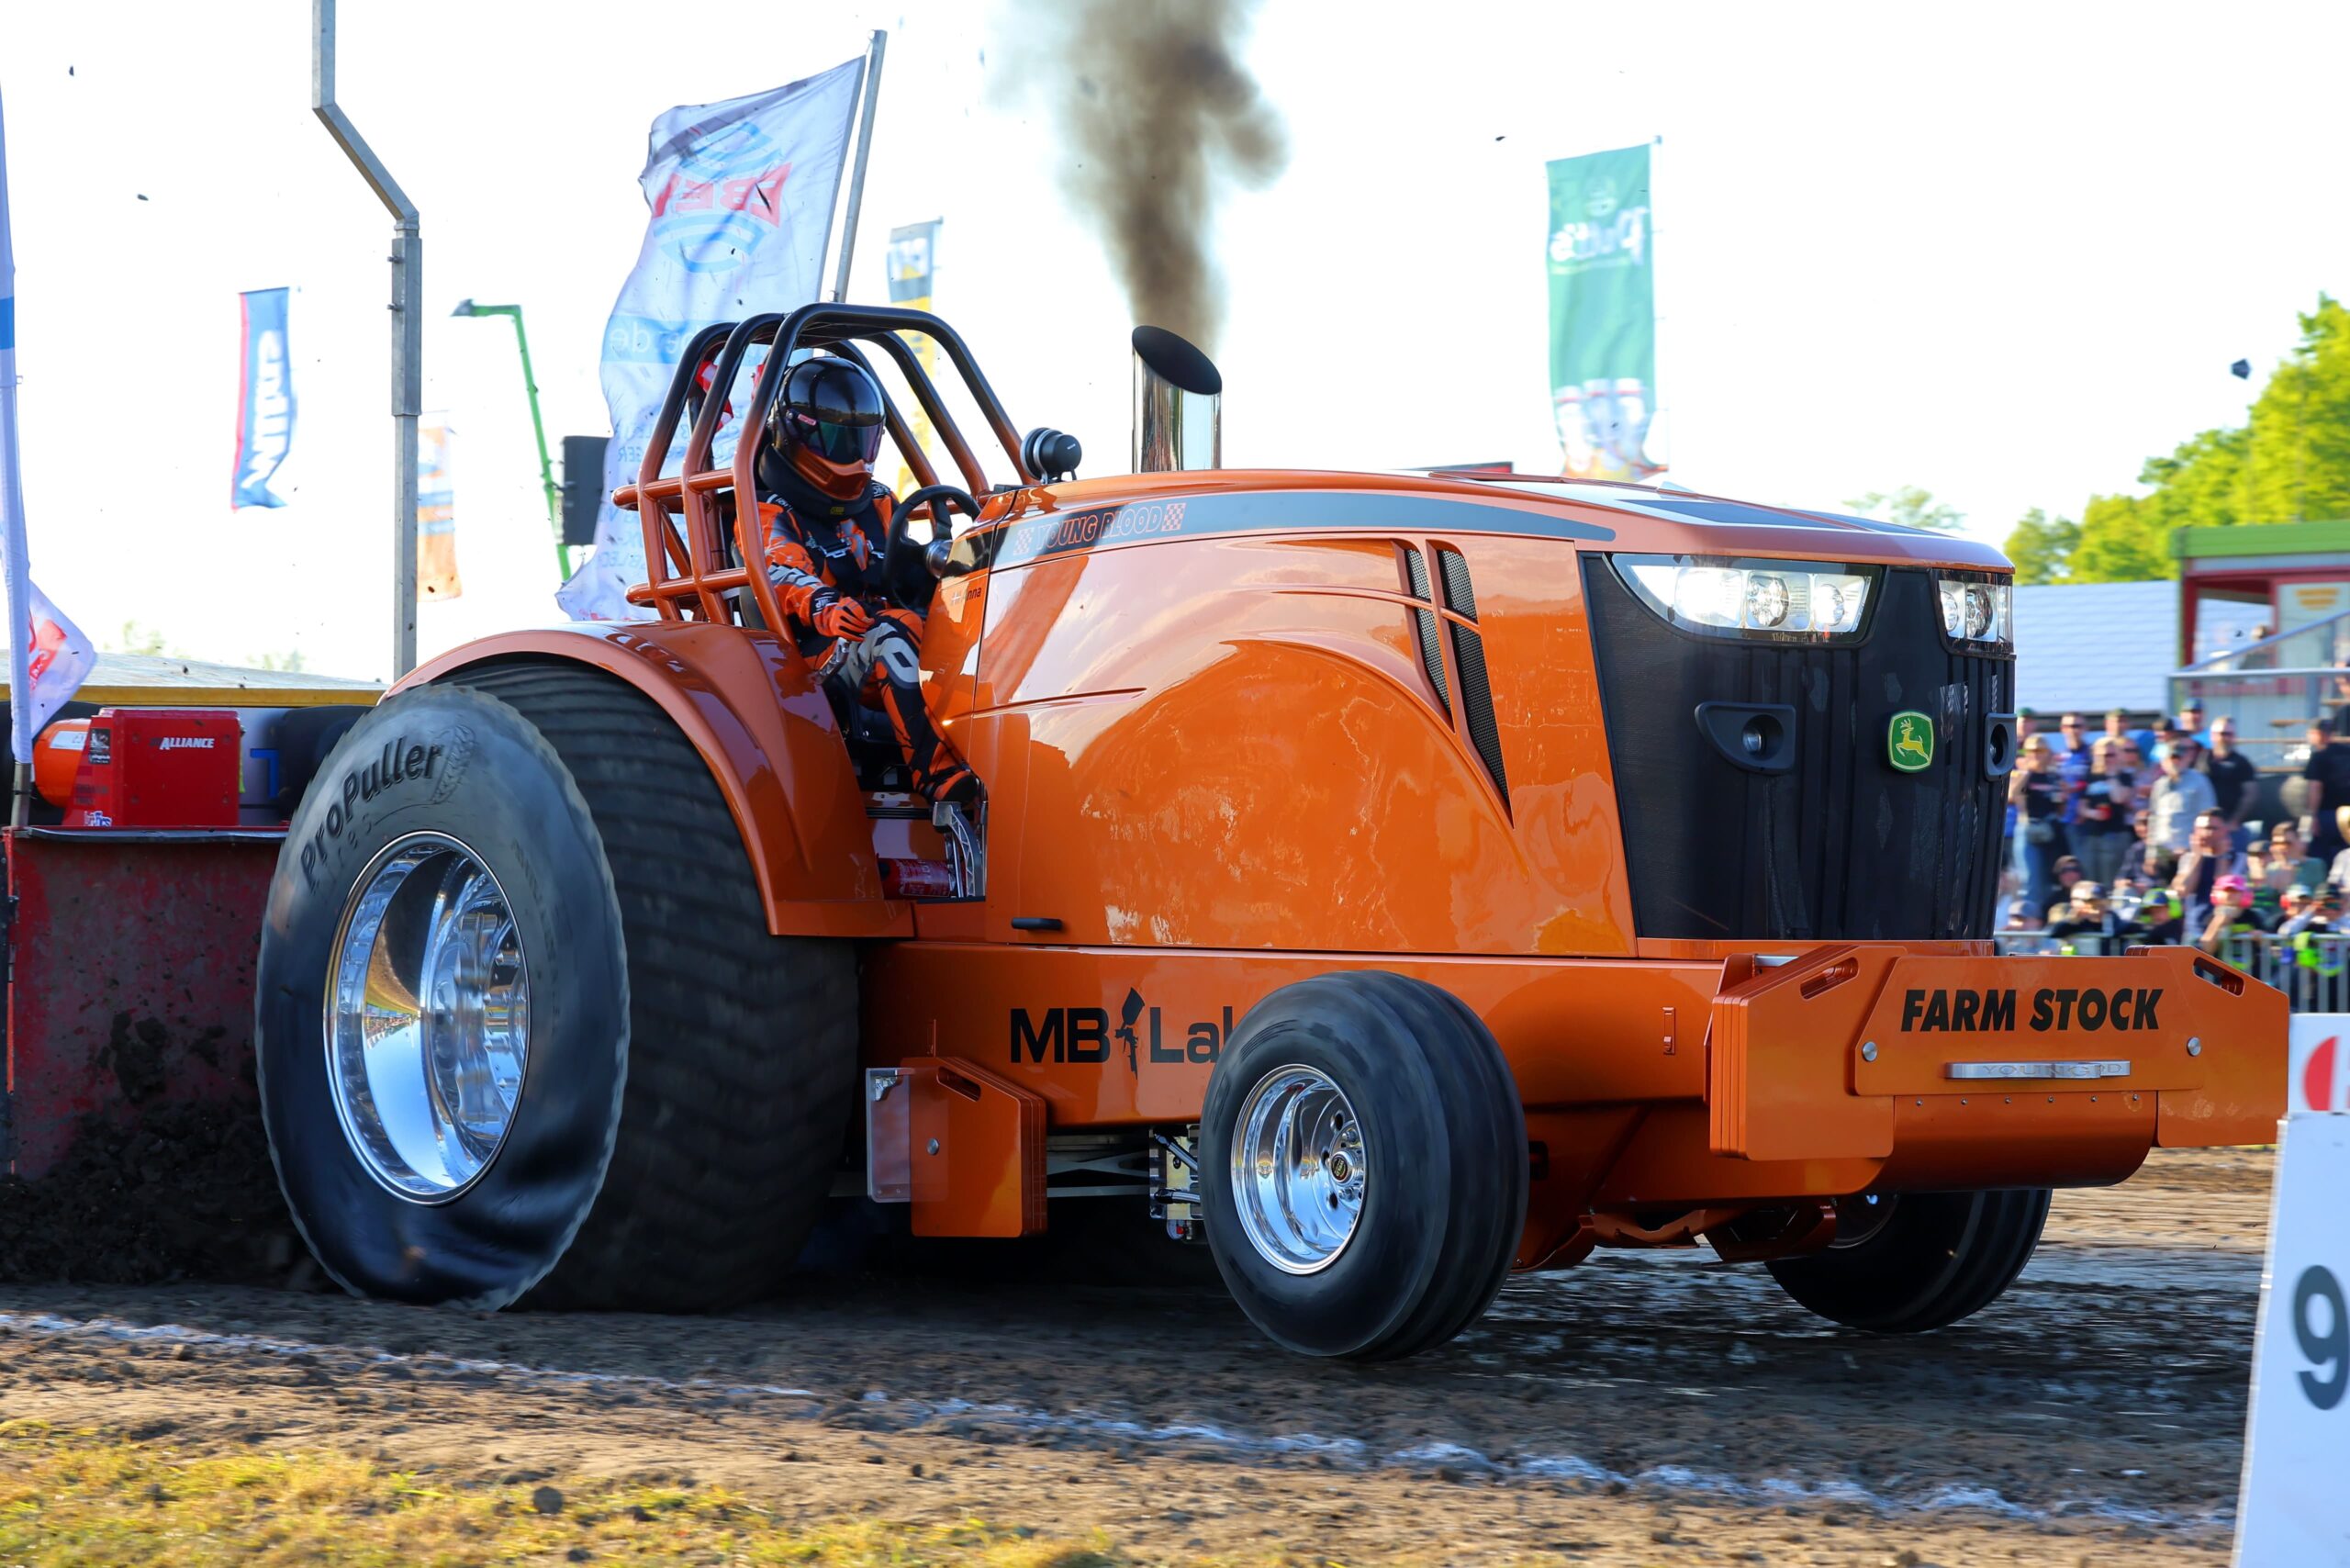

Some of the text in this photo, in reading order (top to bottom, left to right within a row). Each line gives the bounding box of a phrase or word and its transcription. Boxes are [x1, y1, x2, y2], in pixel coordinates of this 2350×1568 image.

[1036, 506, 1163, 551] YOUNG BLOOD
[160, 737, 215, 751] ALLIANCE
[300, 736, 445, 884] ProPuller
[1901, 988, 2165, 1033] FARM STOCK
[1010, 1007, 1111, 1063] MB
